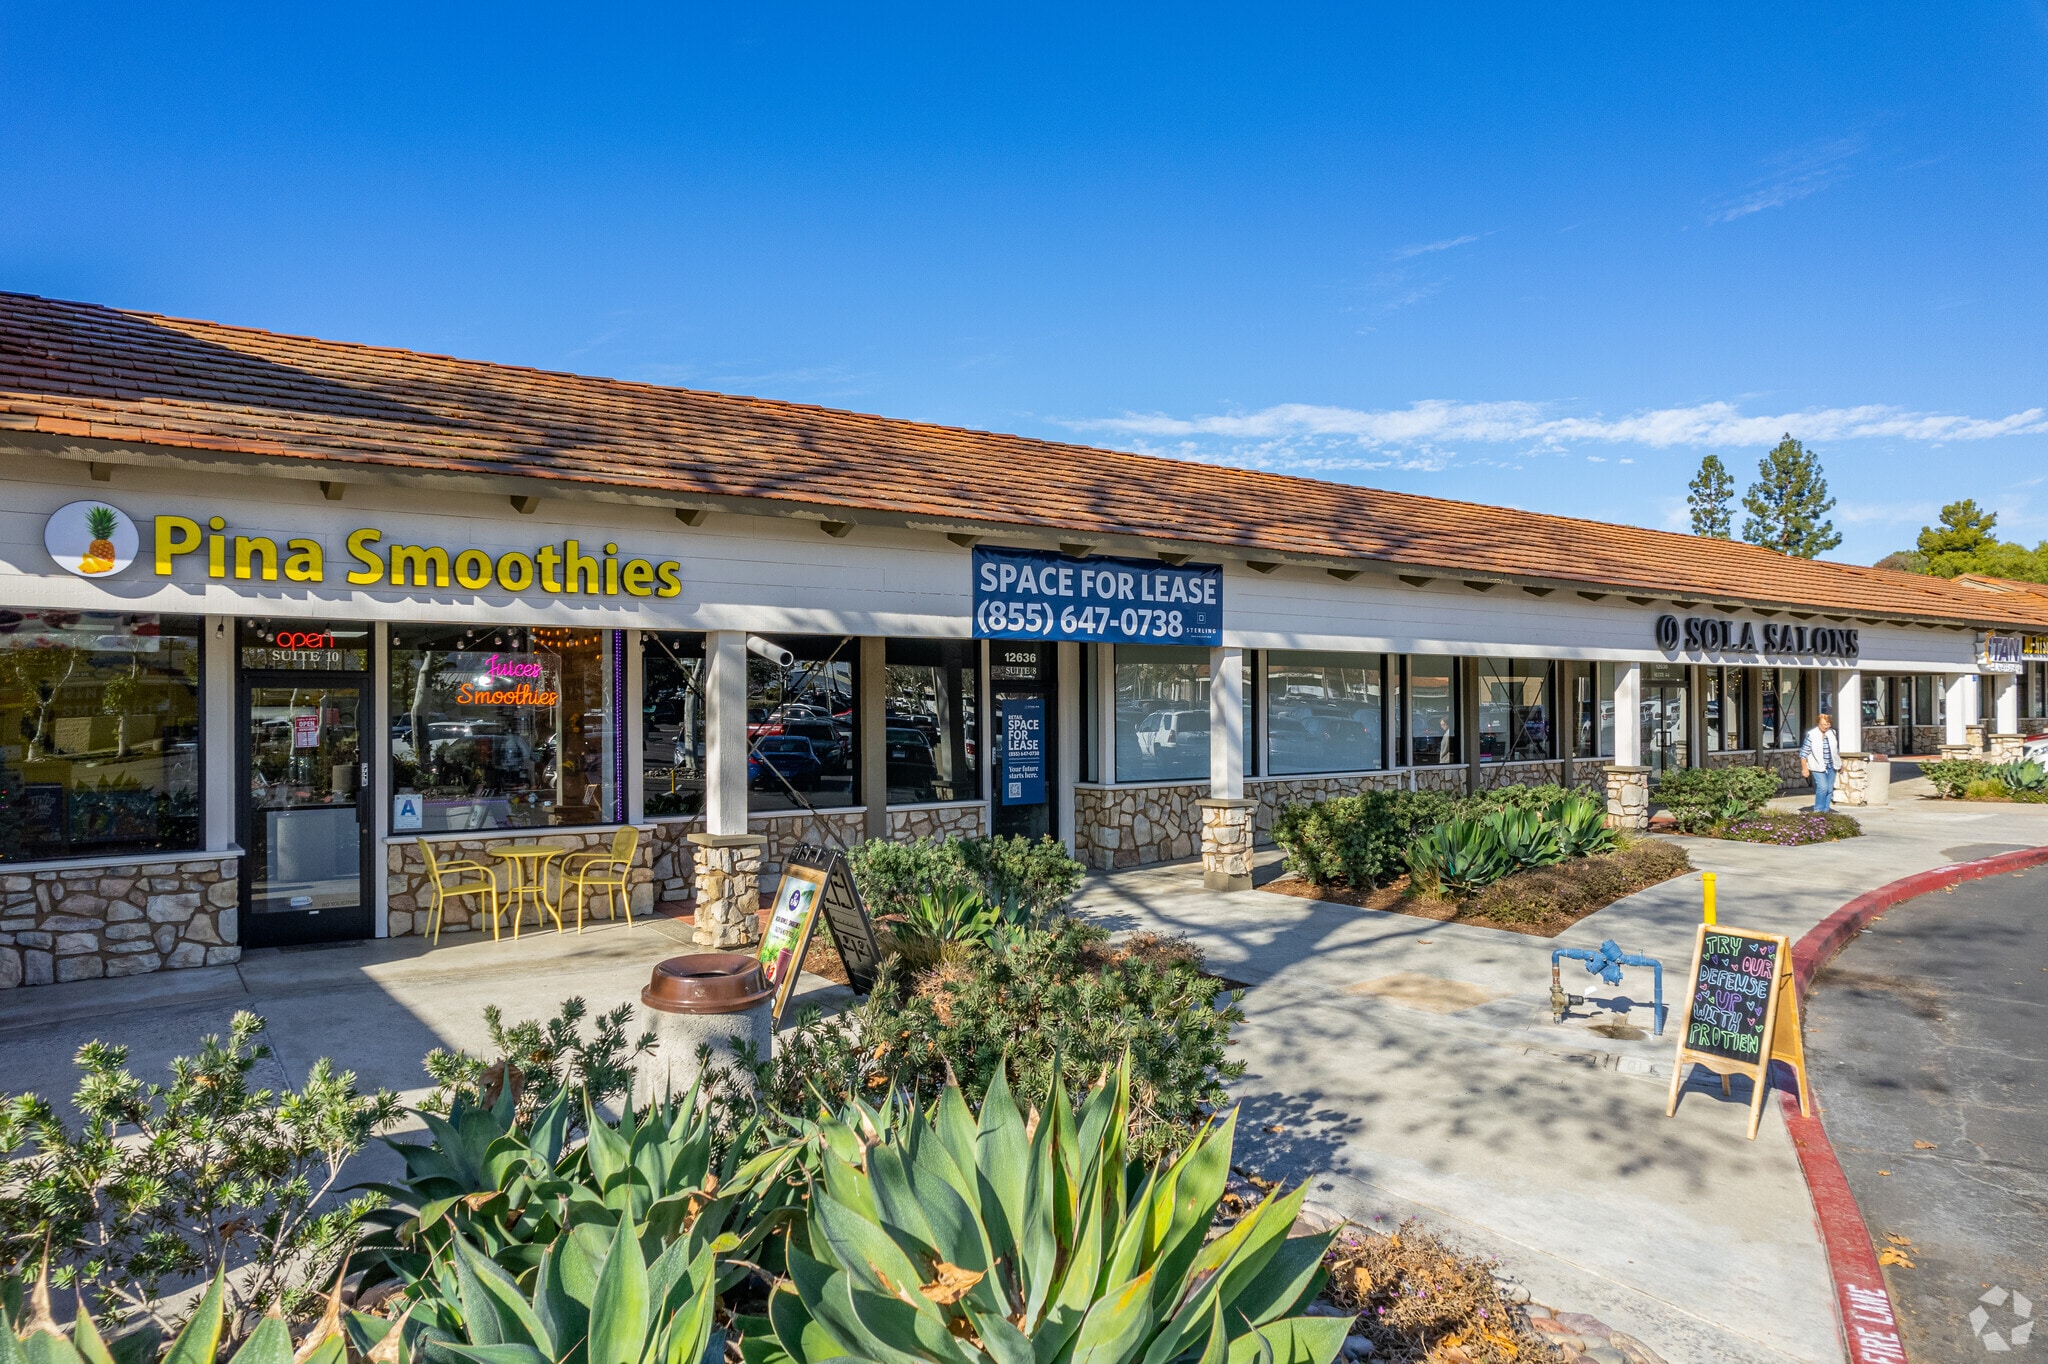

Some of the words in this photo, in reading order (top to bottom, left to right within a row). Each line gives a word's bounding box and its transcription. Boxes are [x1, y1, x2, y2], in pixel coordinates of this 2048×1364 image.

[153, 514, 325, 583] Pina
[345, 527, 683, 599] Smoothies
[979, 561, 1074, 597] SPACE
[1081, 570, 1135, 601] FOR
[1141, 574, 1217, 605] LEASE
[977, 599, 1054, 636] (855)
[1060, 605, 1183, 638] 647-0738
[276, 631, 335, 652] open
[1684, 617, 1759, 655] SOLA
[1764, 623, 1859, 659] SALONS
[272, 650, 320, 662] SUITE
[325, 651, 339, 662] 10
[1004, 652, 1037, 663] 12636
[484, 653, 543, 686] Juices
[1005, 666, 1030, 675] SUITE
[456, 683, 559, 706] Smoothies
[1008, 719, 1039, 730] SPACE
[1008, 730, 1028, 740] FOR
[1008, 739, 1039, 751] LEASE
[401, 799, 417, 816] A
[1705, 936, 1742, 956] TRY
[1742, 956, 1773, 979] OUR
[1699, 964, 1768, 999] DEFENSE
[1715, 989, 1742, 1012] UP
[1693, 1003, 1742, 1033] WITH
[1689, 1023, 1759, 1054] PROTIEN
[1844, 1283, 1895, 1326] LANE
[1856, 1326, 1906, 1364] FIRE
